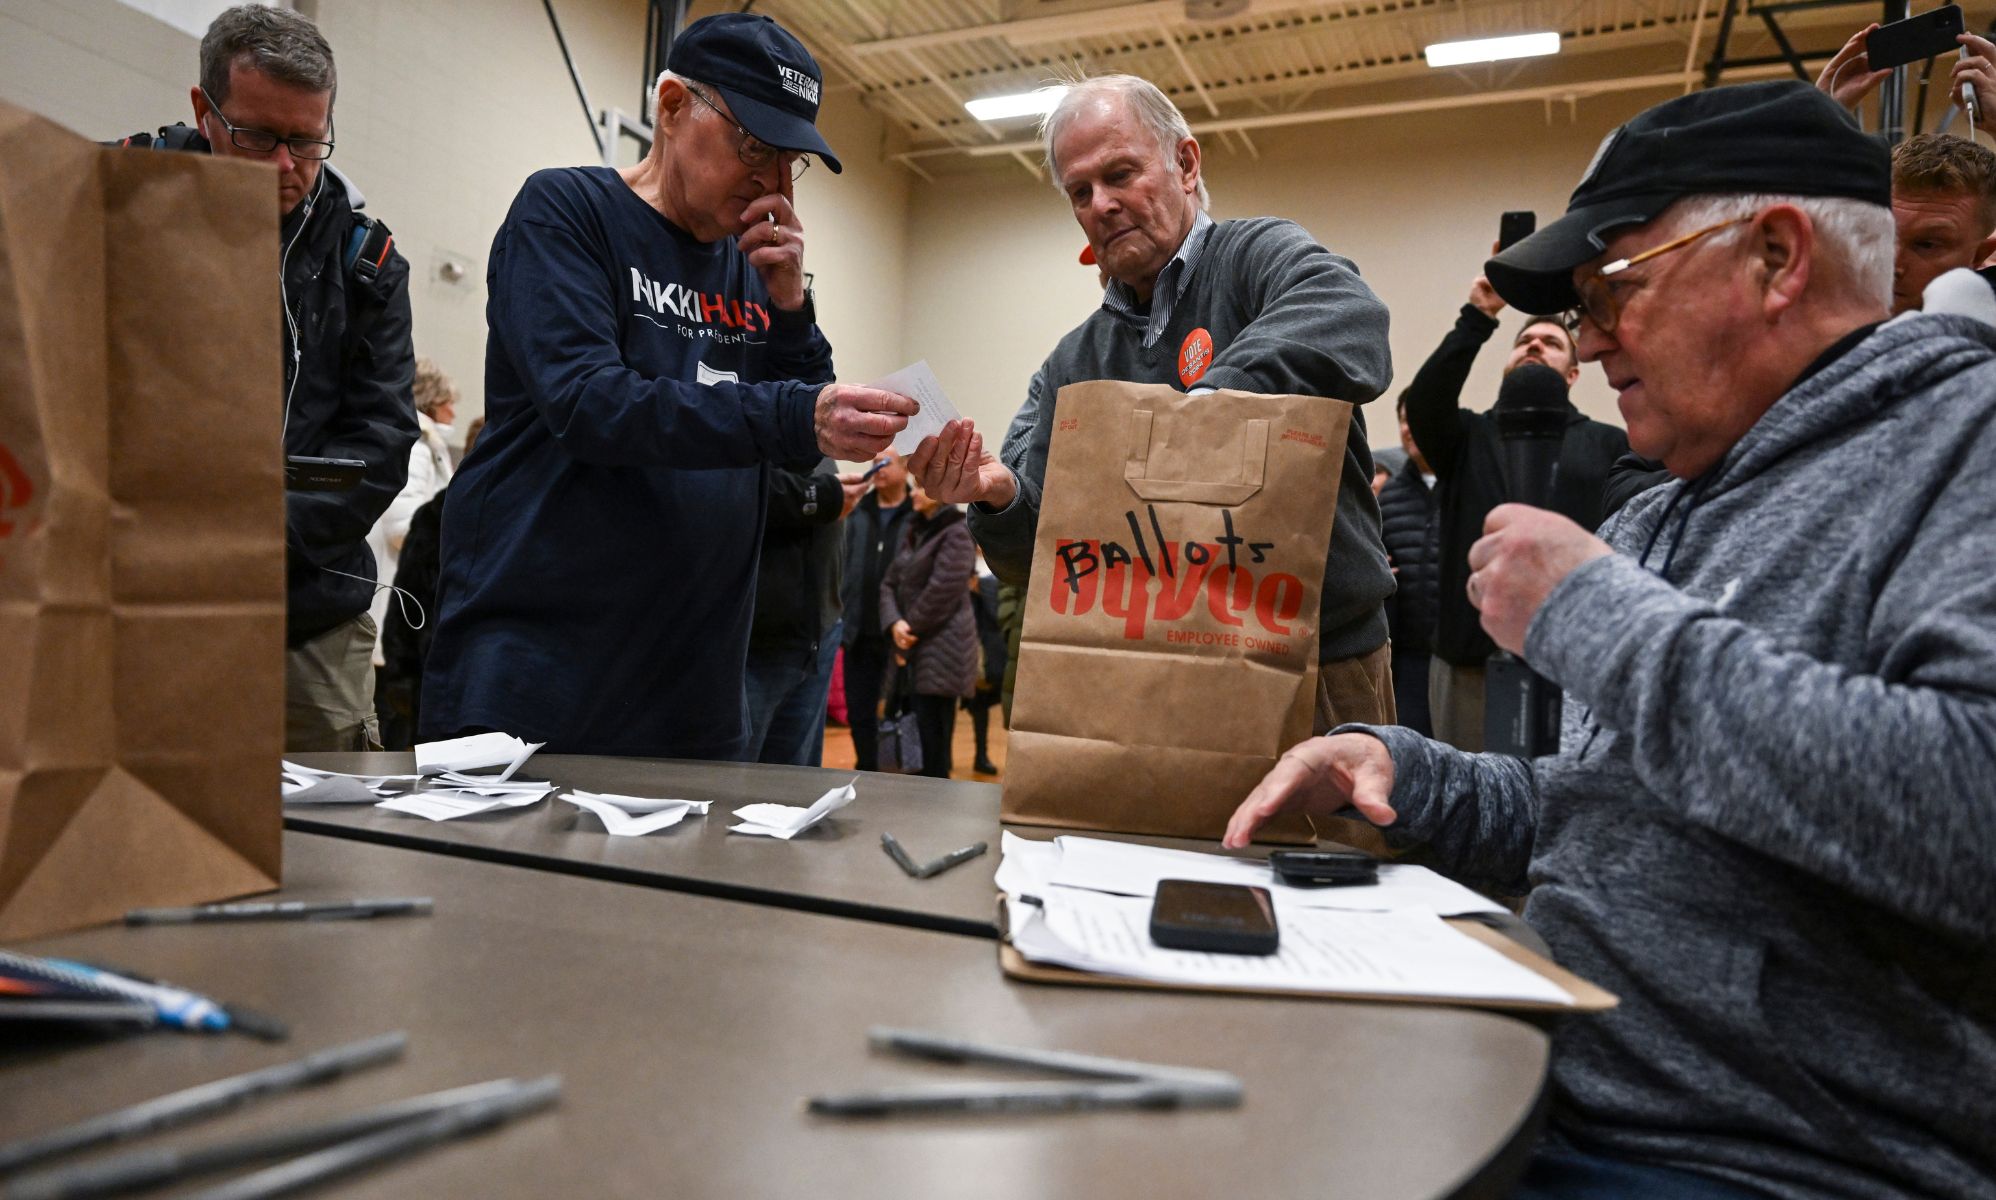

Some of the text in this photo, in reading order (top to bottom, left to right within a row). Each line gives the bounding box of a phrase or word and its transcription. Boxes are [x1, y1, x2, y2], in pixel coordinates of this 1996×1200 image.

[777, 64, 819, 93] VETERAN
[798, 84, 818, 105] NIKKI
[630, 266, 703, 323] NIKKI
[677, 324, 747, 344] FOR PREDENT
[1183, 338, 1202, 363] VOTE
[1166, 629, 1290, 656] EMPLOYEE OWNED
